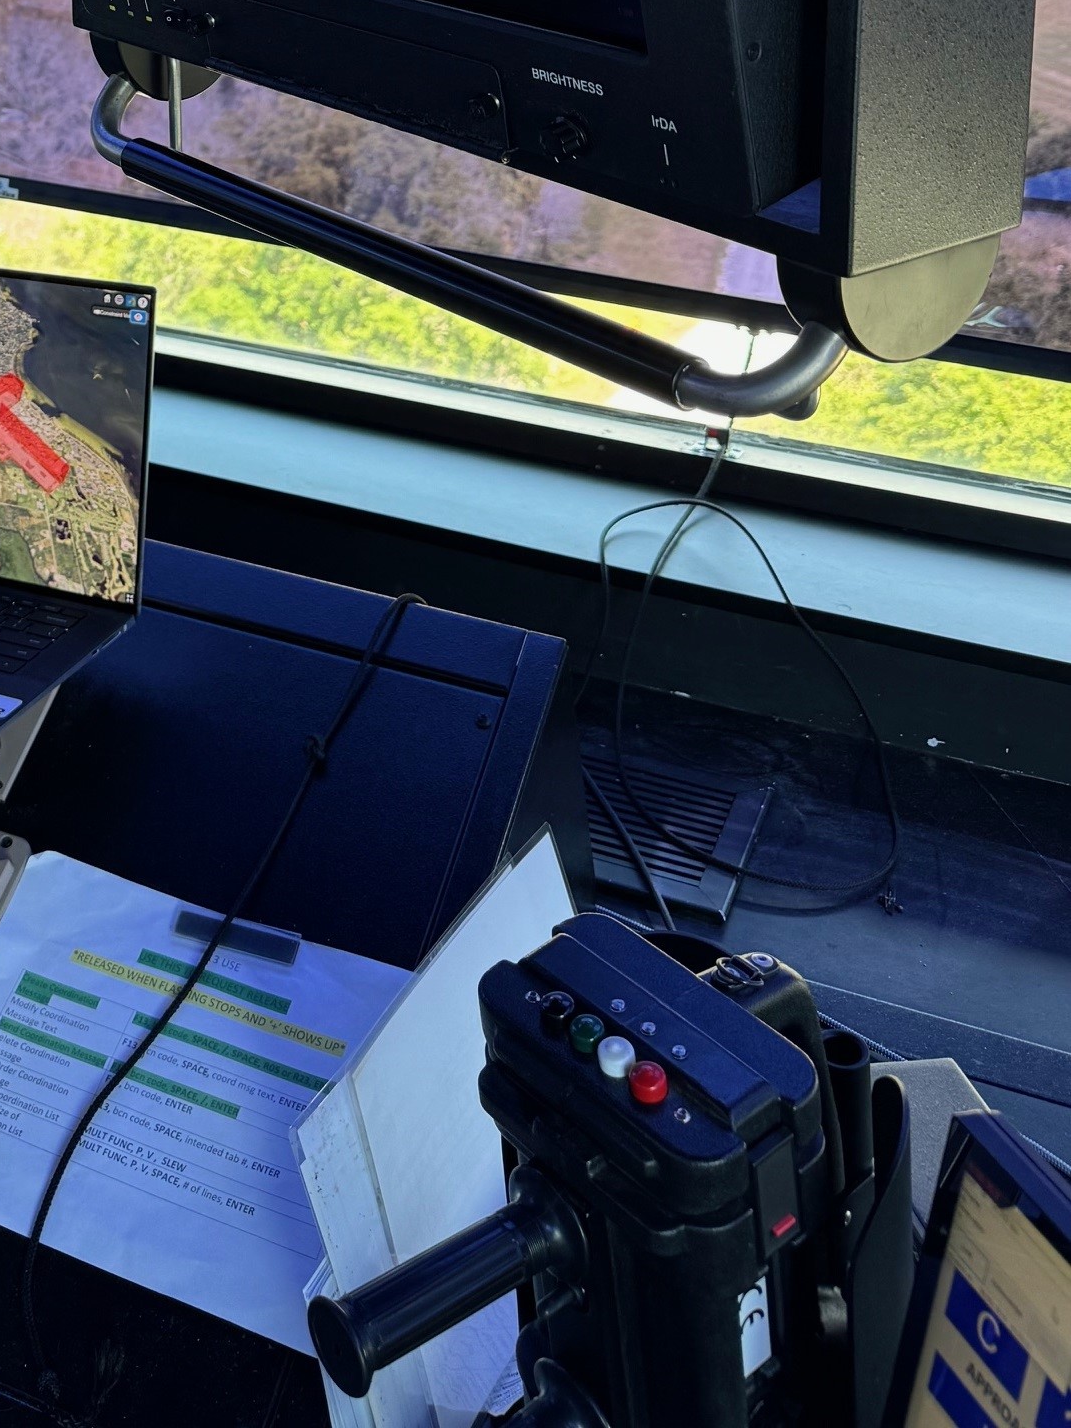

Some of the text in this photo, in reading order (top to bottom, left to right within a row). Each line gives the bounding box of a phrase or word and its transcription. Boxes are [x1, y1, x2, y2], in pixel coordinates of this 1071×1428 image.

[532, 67, 604, 96] BRIGHTNESS
[651, 115, 677, 134] IrDA
[221, 956, 242, 972] USE
[127, 968, 157, 988] WHEN
[159, 979, 208, 1005] FLASING
[209, 998, 240, 1017] STOPS
[243, 1011, 265, 1027] AND
[283, 1026, 322, 1047] SHOWS
[246, 989, 288, 1010] RELEASE
[5, 1008, 57, 1034] Message Text
[11, 996, 89, 1032] Modify Coordination
[0, 1018, 19, 1032] Send
[20, 1026, 70, 1053] Coordination
[20, 1043, 70, 1067] Coordination
[18, 1070, 69, 1096] Coordination
[159, 1052, 276, 1104] code, SPACE, coord msg text,
[124, 1081, 192, 1114] bcn code, ENTER
[211, 1099, 239, 1115] ENTER
[11, 1111, 21, 1121] of
[45, 1108, 60, 1122] List
[9, 1122, 23, 1136] List
[113, 1106, 127, 1118] bcn
[129, 1113, 151, 1129] code,
[154, 1123, 182, 1142] SPACE,
[184, 1135, 222, 1158] intended
[225, 1150, 239, 1164] tab
[252, 1161, 280, 1179] ENTER
[108, 1135, 134, 1153] FUNC,
[162, 1156, 187, 1172] SLEW
[103, 1149, 129, 1167] FUNC,
[151, 1168, 181, 1189] SPACE,
[183, 1181, 189, 1189] #
[191, 1184, 200, 1195] of
[201, 1188, 223, 1206] lines,
[226, 1199, 255, 1216] ENTER
[977, 1310, 1000, 1354] C
